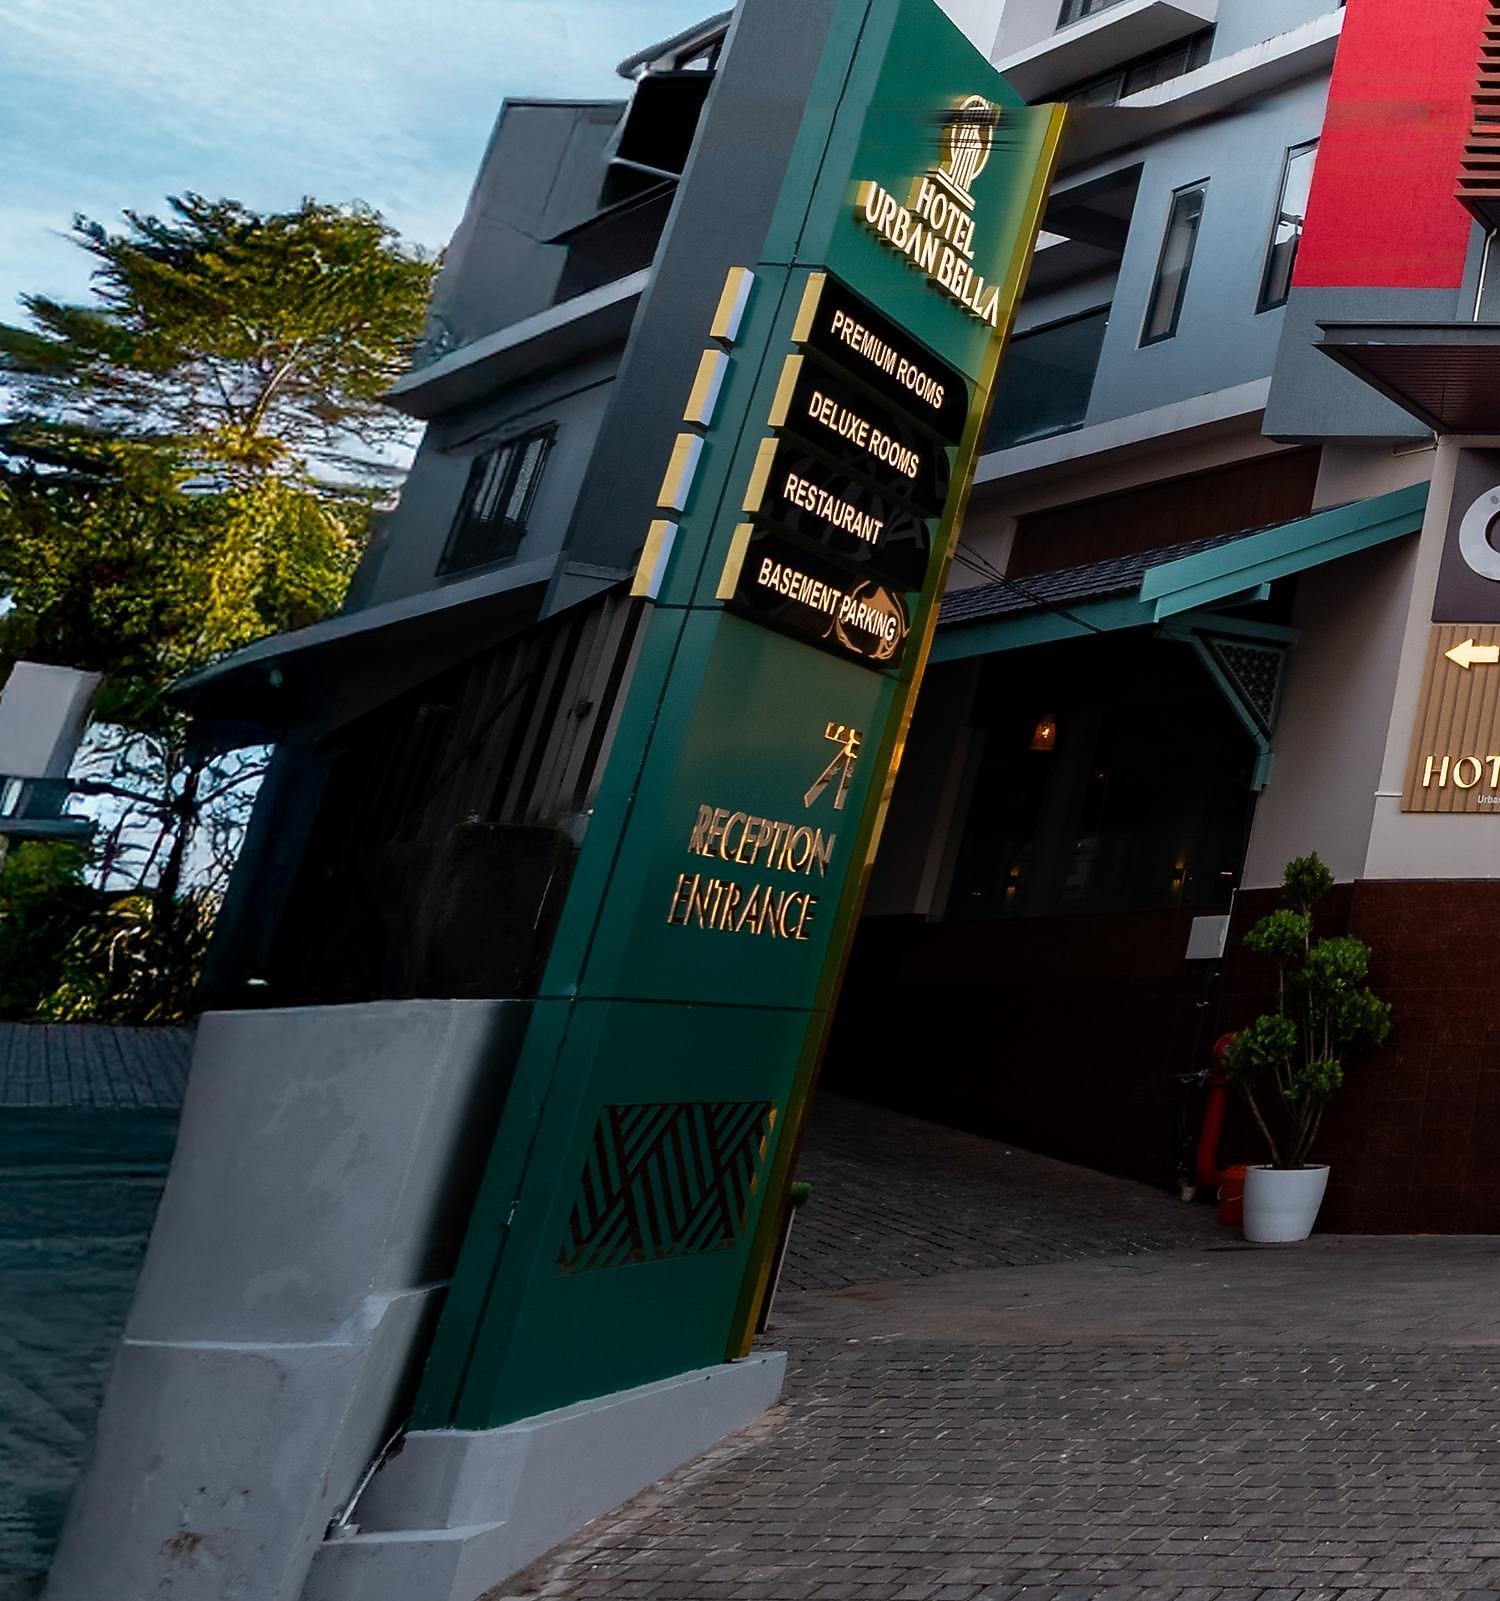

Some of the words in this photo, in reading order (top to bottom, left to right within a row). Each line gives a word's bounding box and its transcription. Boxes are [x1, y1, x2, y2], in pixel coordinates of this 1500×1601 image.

[863, 180, 940, 274] URBAN
[936, 245, 1000, 328] BELLA
[914, 176, 976, 260] HOTEL
[830, 309, 896, 374] PREMIUM
[896, 355, 945, 410] ROOMS
[808, 390, 870, 449] DELUXE
[870, 429, 919, 479] ROOMS
[782, 472, 884, 545] RESTAURANT
[757, 557, 842, 616] BASEMENT
[838, 595, 897, 642] PARKING
[687, 803, 837, 879] RECEPTION
[666, 872, 819, 941] ENTRANCE
